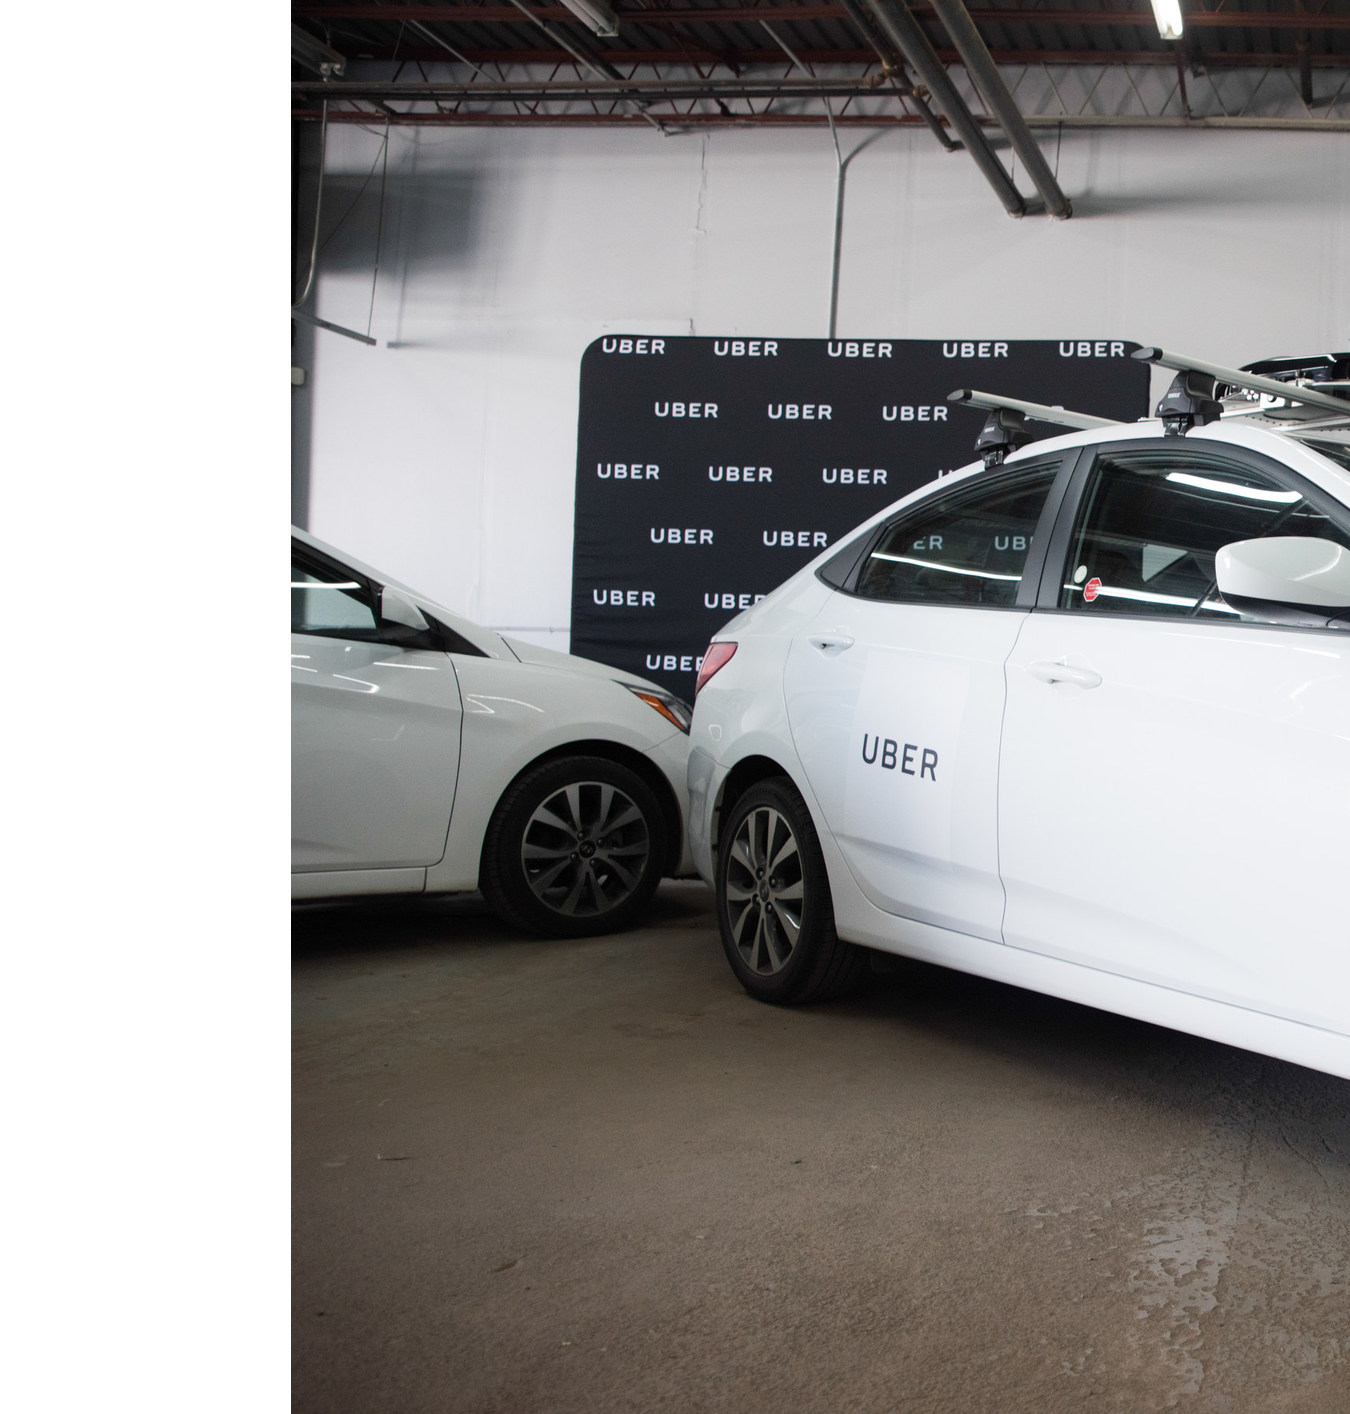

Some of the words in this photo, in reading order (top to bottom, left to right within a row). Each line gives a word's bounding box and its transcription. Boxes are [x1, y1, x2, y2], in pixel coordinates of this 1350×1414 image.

[601, 339, 666, 355] UBER
[713, 341, 778, 357] UBER
[827, 342, 893, 358] UBER
[942, 342, 1009, 358] UBER
[1058, 341, 1125, 357] UBER
[654, 401, 719, 418] UBER
[767, 403, 832, 420] UBER
[882, 405, 948, 422] UBER
[597, 463, 660, 480] UBER
[708, 465, 773, 483] UBER
[822, 468, 888, 485] UBER
[650, 527, 714, 545] UBER
[762, 530, 828, 548] UBER
[593, 589, 656, 607] UBER
[862, 733, 938, 782] UBER
